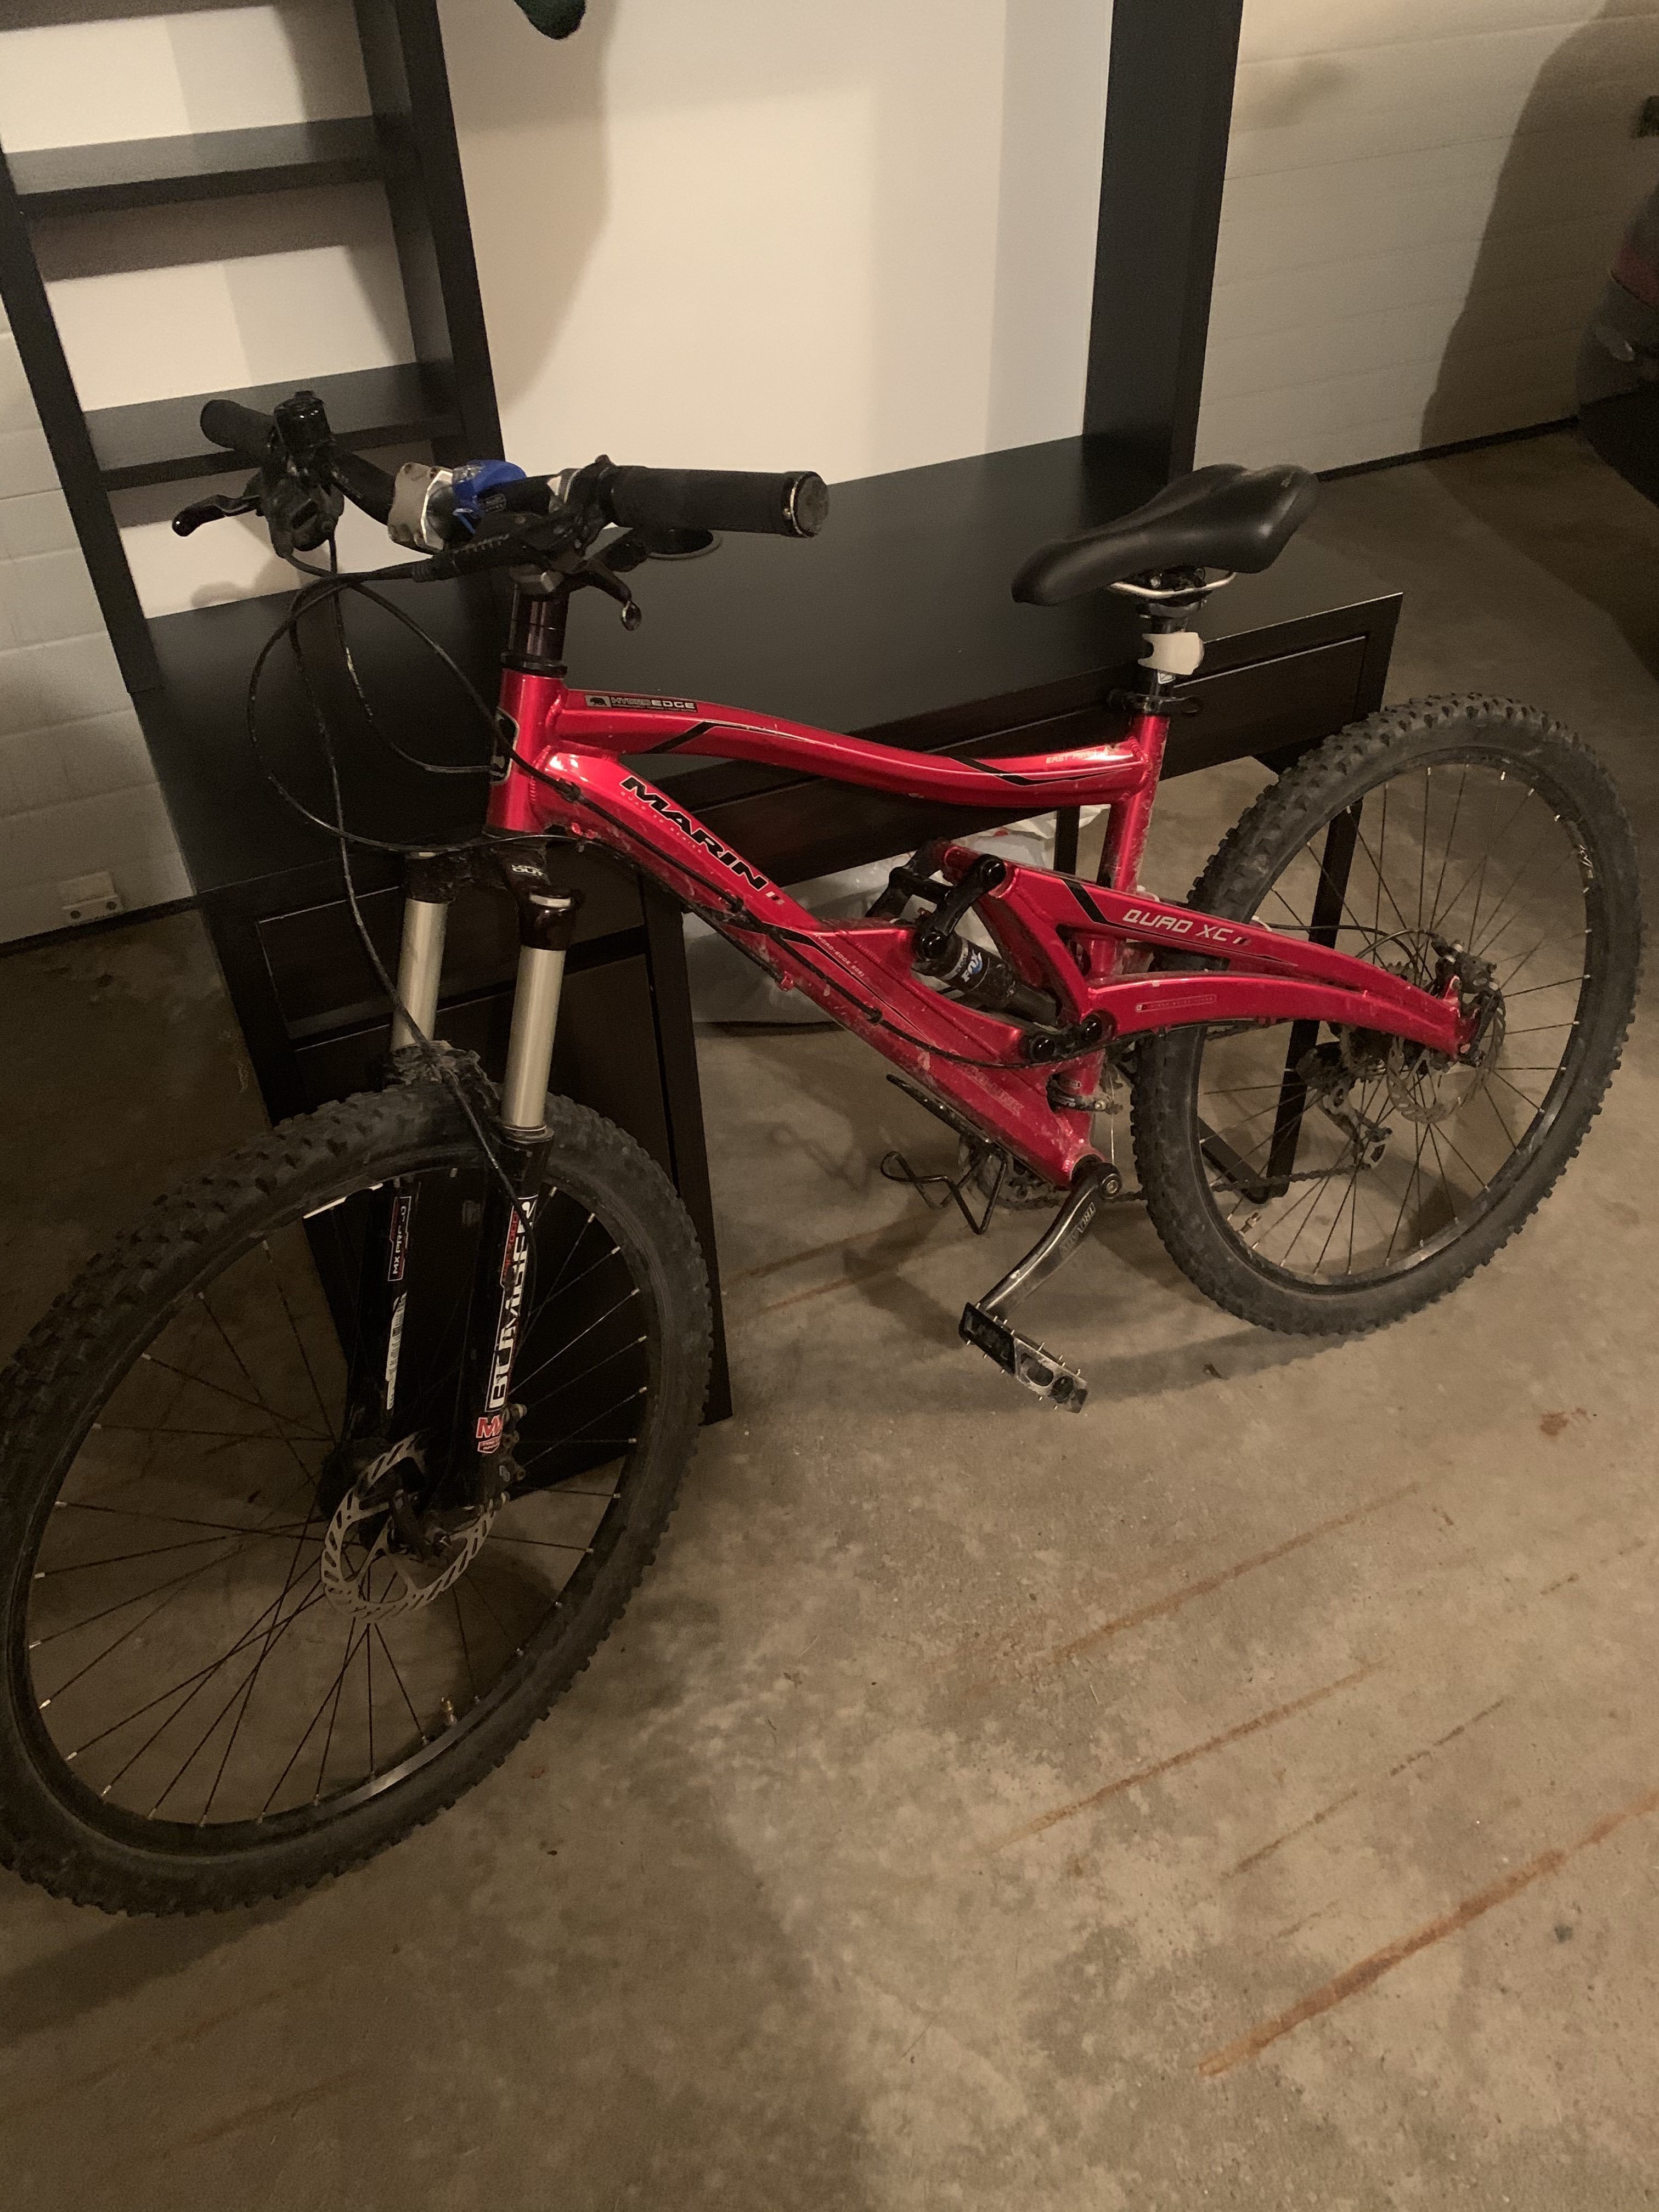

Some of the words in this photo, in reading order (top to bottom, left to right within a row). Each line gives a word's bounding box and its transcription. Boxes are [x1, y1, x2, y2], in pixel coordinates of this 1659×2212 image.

[1046, 755, 1069, 764] EAST
[619, 775, 769, 891] MARIN
[1122, 909, 1194, 933] QUAD
[1195, 924, 1234, 941] XC
[962, 949, 983, 983] FOX
